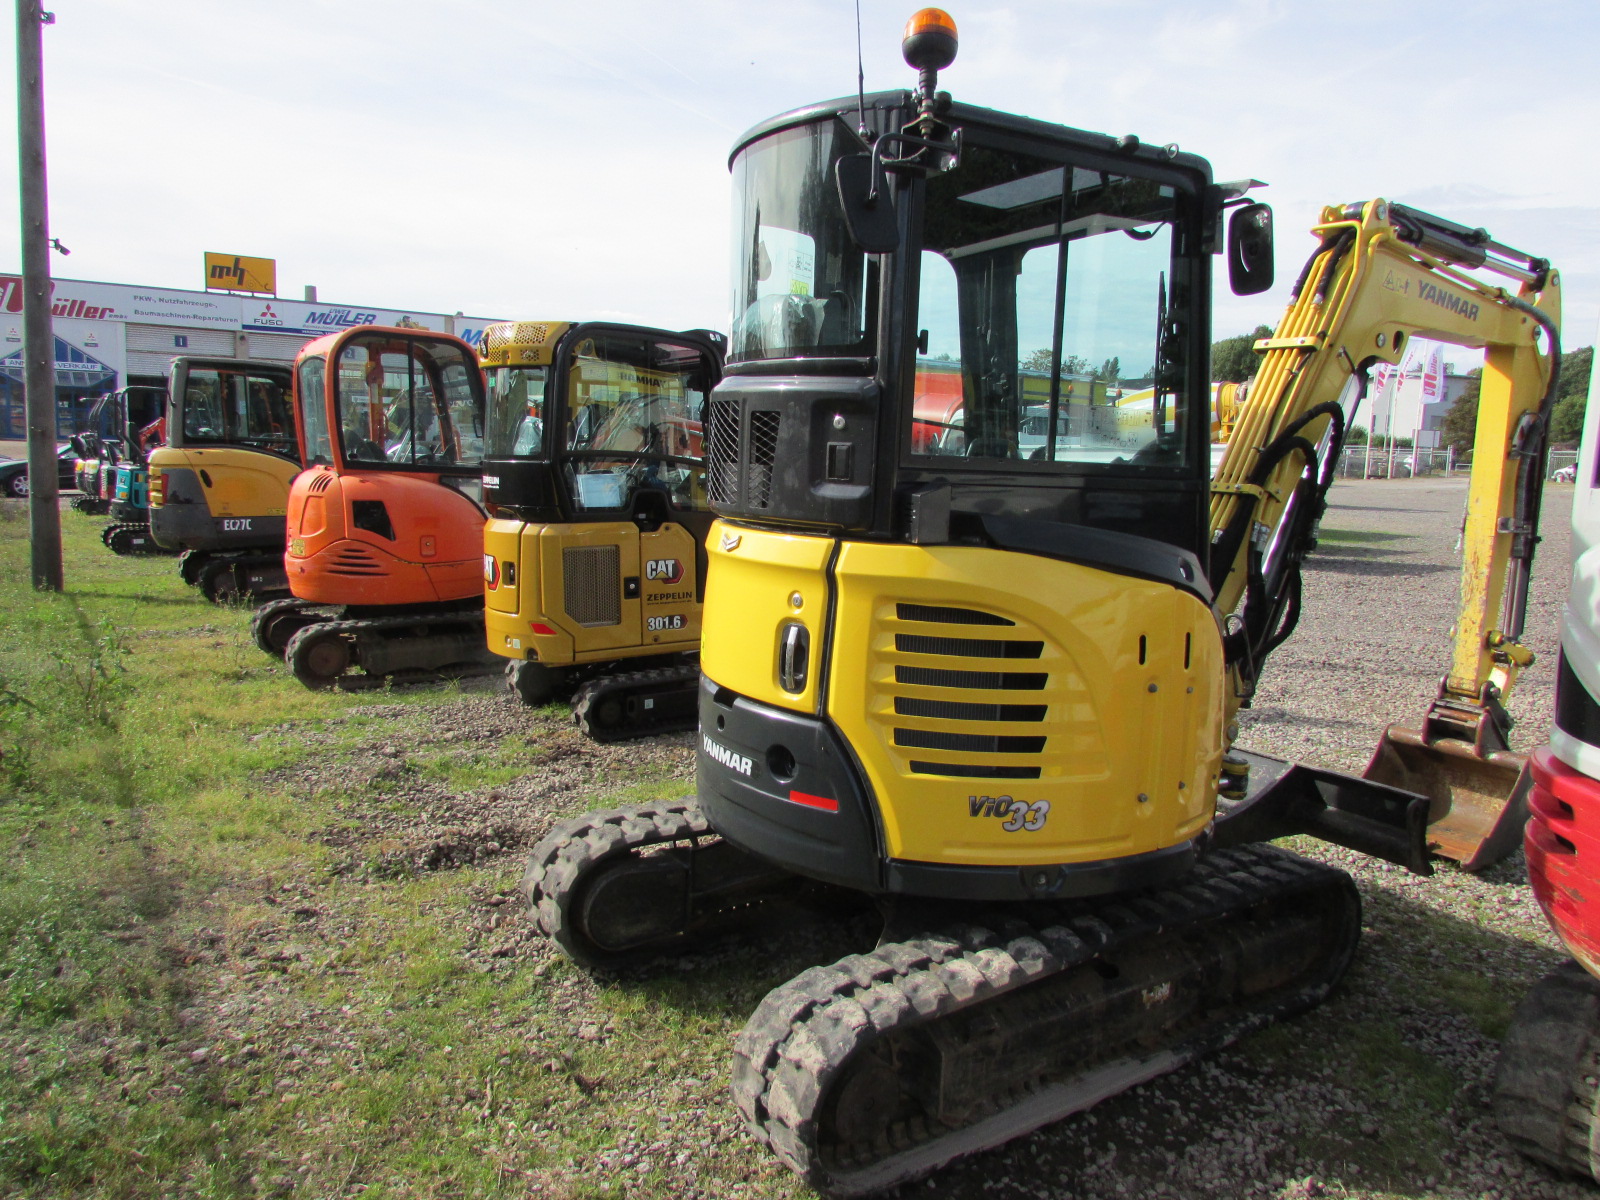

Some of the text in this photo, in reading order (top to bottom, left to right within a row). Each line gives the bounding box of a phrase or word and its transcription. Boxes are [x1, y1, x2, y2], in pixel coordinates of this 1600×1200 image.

[1418, 279, 1479, 321] YANMAR
[253, 318, 283, 326] FUSO
[224, 519, 252, 530] EC27C
[646, 559, 675, 580] CAT
[646, 592, 692, 601] ZEPPELIN
[647, 615, 681, 631] 301.6
[703, 733, 753, 776] YANMAR
